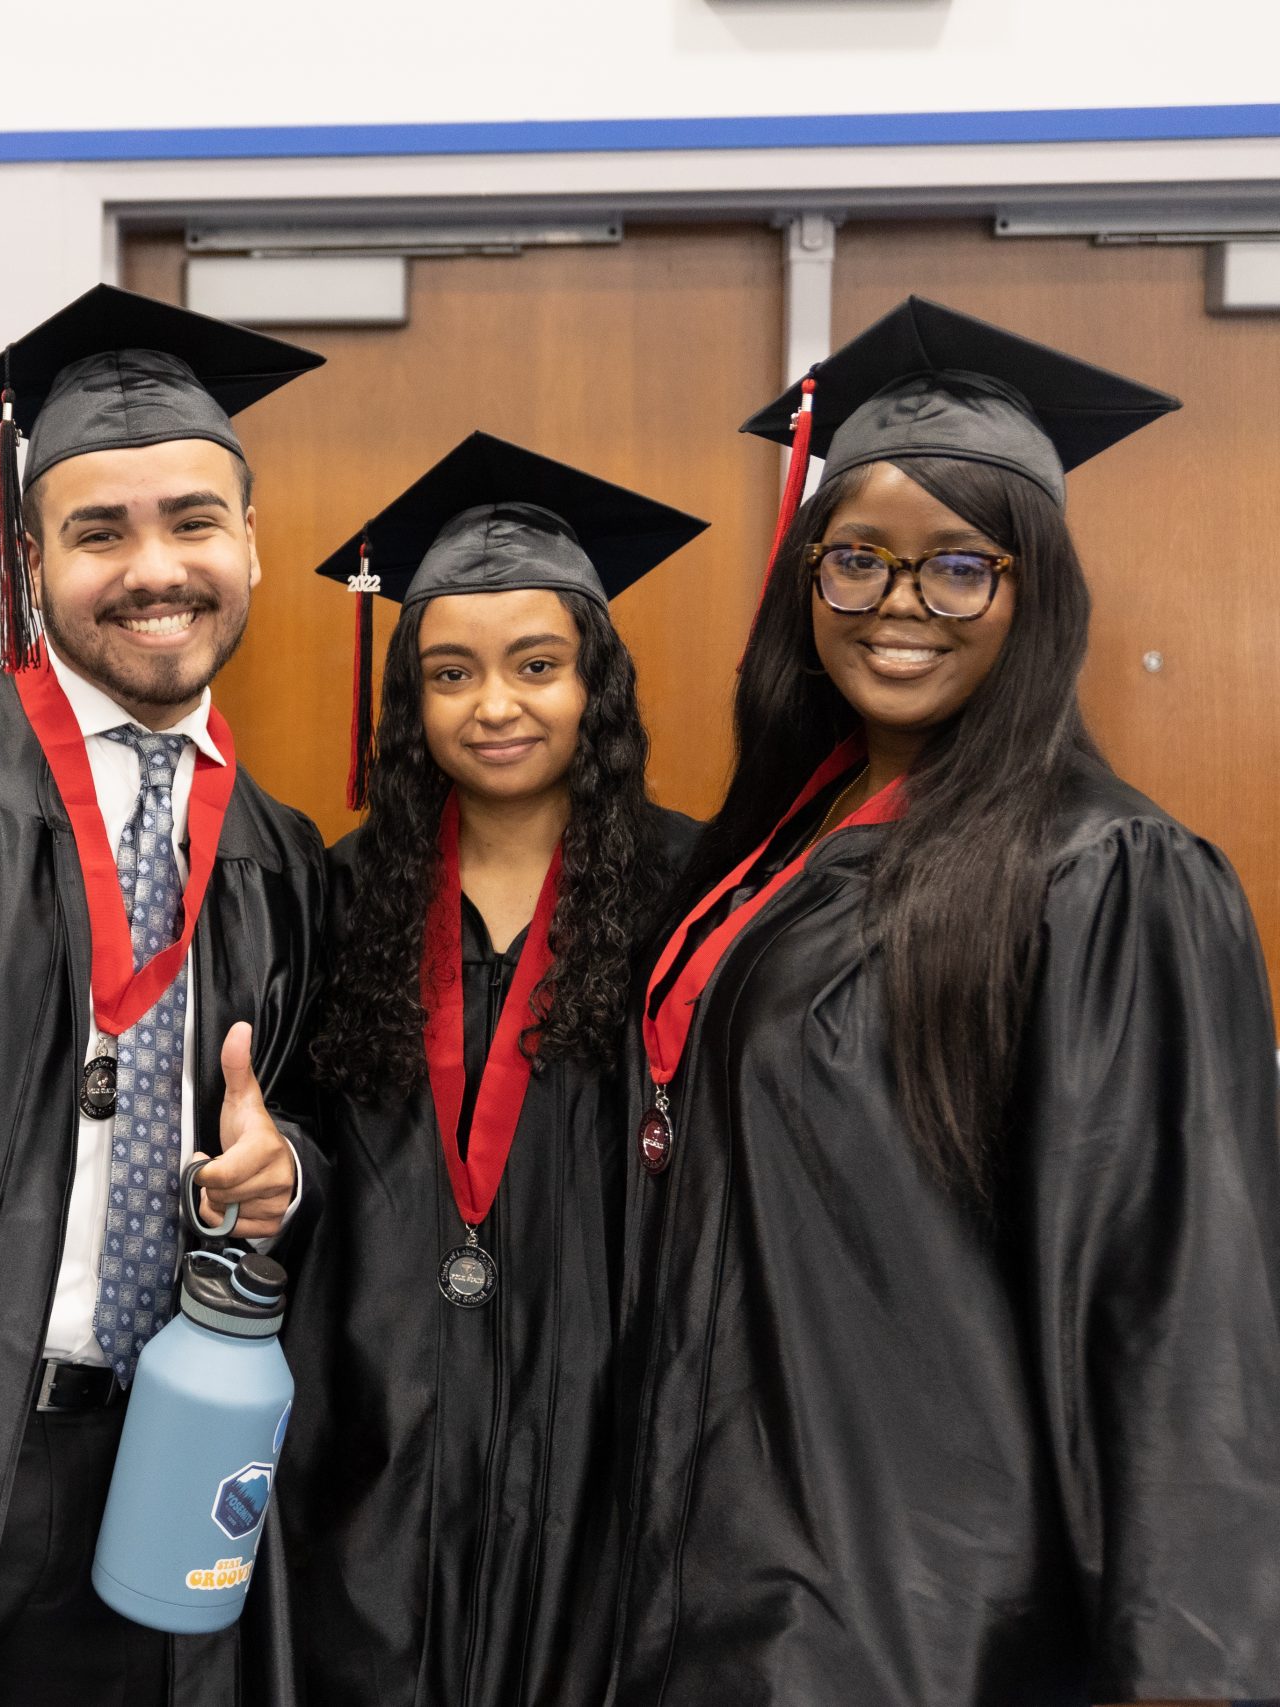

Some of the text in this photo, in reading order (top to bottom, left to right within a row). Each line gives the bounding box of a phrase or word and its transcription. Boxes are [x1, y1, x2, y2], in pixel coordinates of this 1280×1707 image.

[347, 574, 381, 592] 2022
[225, 1492, 254, 1526] YOSEMITE
[189, 1562, 252, 1587] GROOVY
[216, 1559, 241, 1570] STAY
